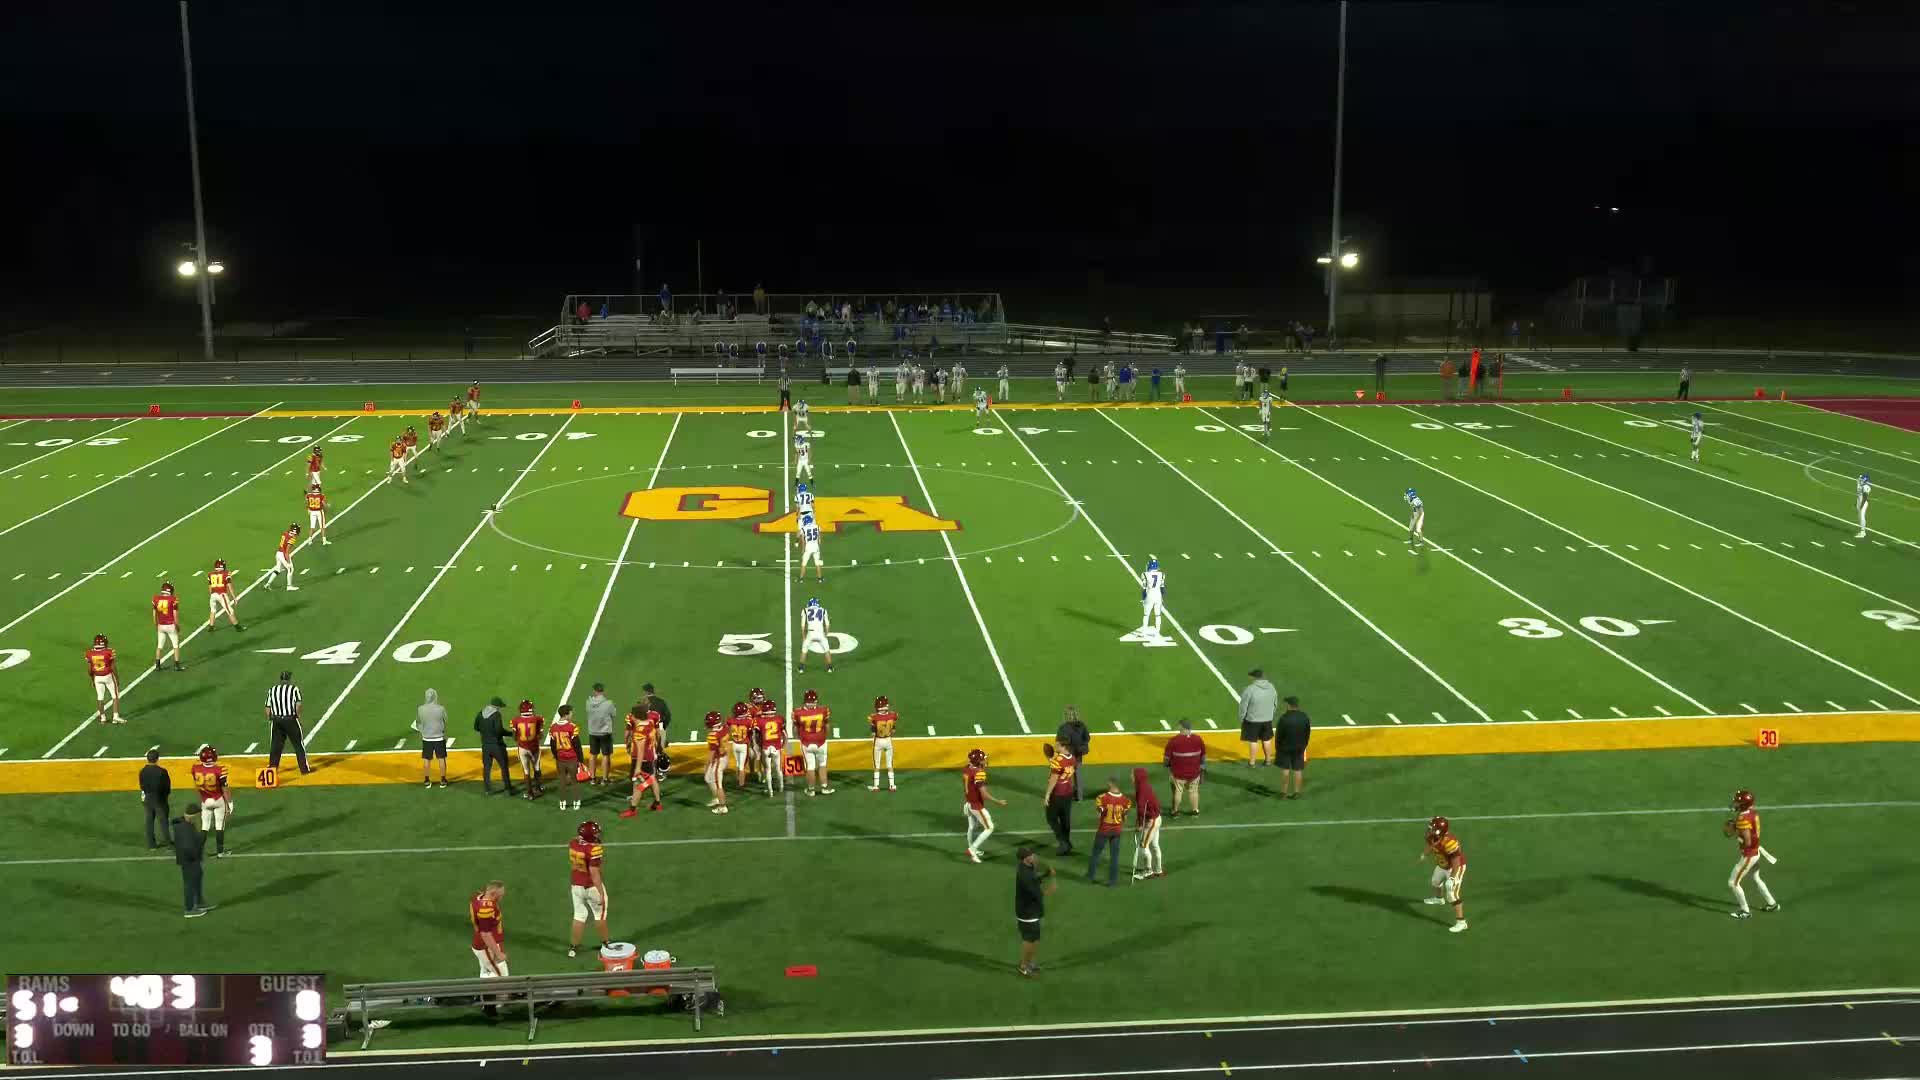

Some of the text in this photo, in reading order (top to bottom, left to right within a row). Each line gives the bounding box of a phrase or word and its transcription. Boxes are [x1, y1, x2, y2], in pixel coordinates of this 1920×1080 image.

[1150, 574, 1159, 589] 7
[156, 600, 169, 615] 4
[806, 607, 824, 623] 24
[91, 655, 105, 671] 5
[764, 721, 778, 740] 2
[800, 714, 824, 733] 77
[1761, 730, 1778, 746] 30
[786, 756, 804, 775] 50
[257, 769, 276, 787] 40
